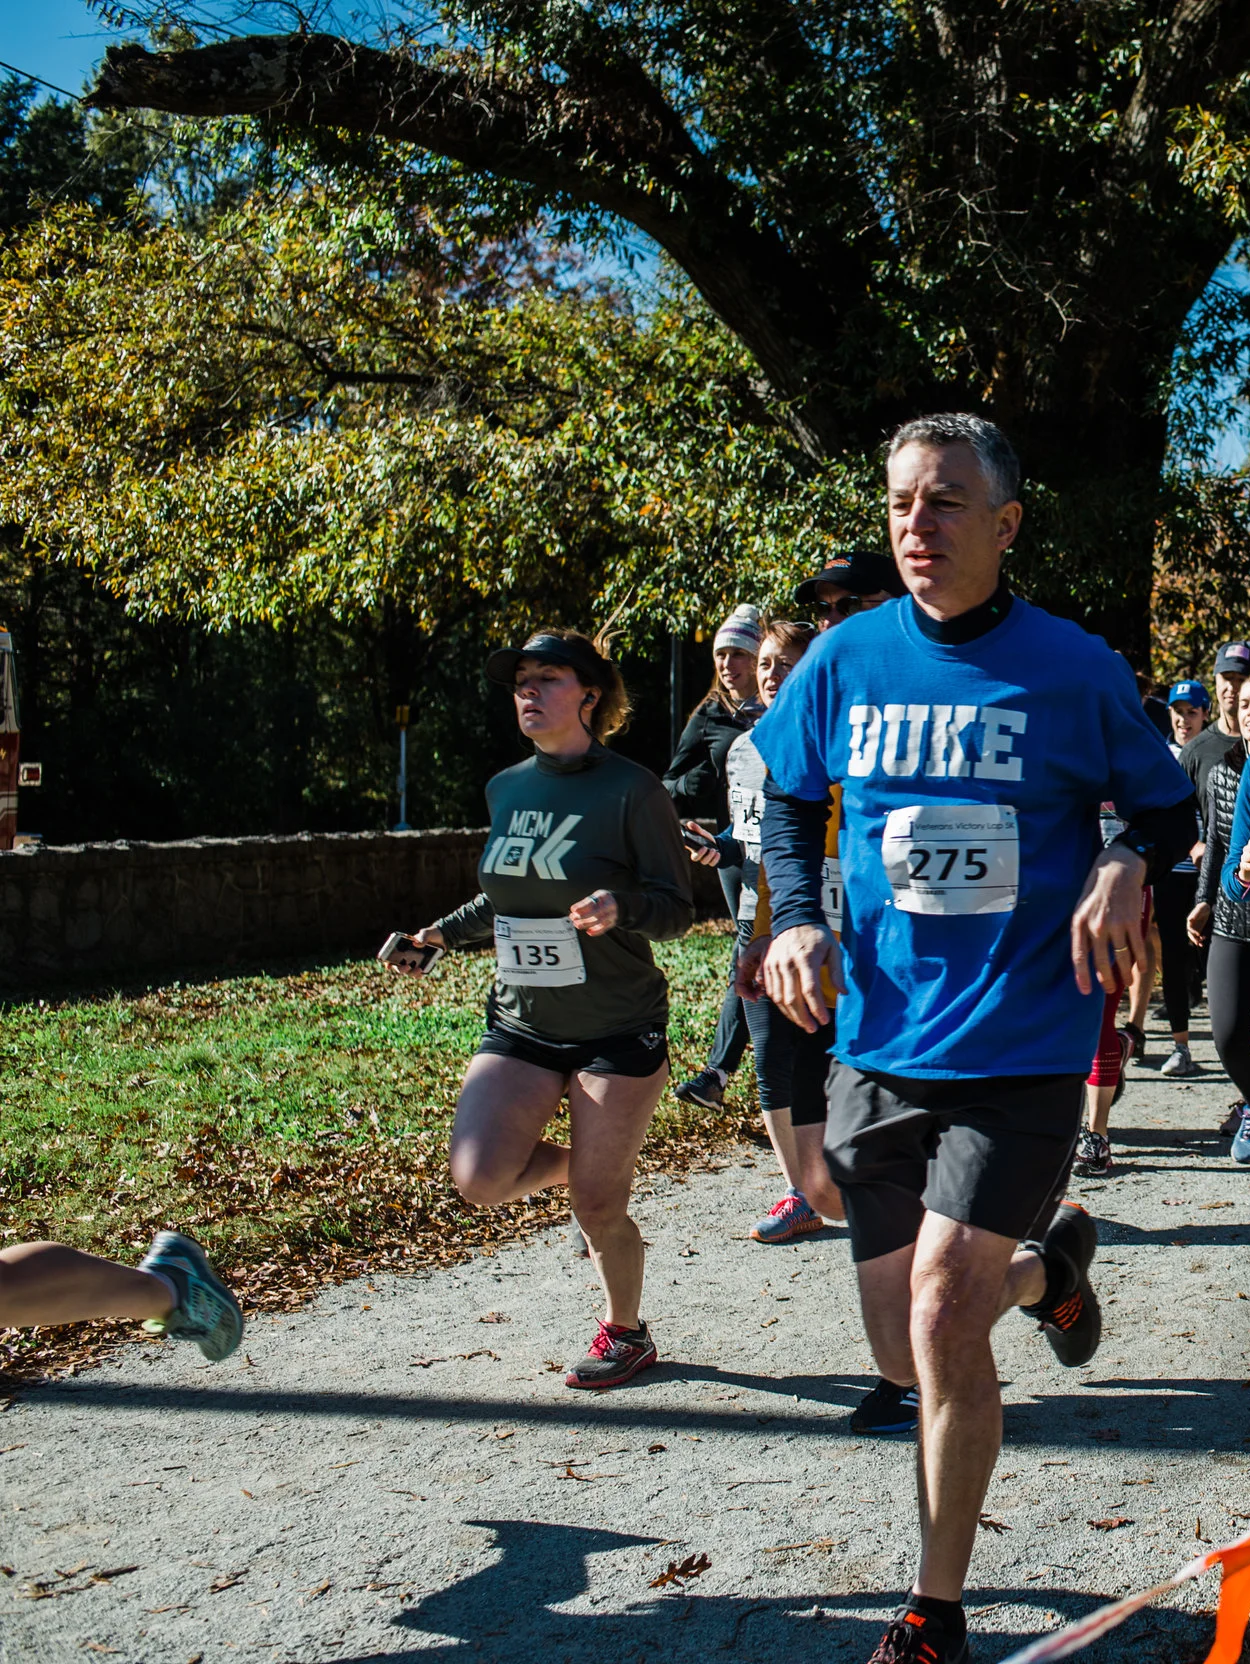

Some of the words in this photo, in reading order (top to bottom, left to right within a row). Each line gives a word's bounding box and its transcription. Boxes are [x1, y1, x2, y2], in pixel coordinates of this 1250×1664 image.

[848, 704, 1028, 781] DUKE
[508, 810, 554, 838] MCM
[915, 822, 953, 831] Veterans
[956, 822, 984, 831] Victory
[987, 822, 1003, 831] Lap
[908, 848, 988, 881] 275
[512, 945, 560, 966] 135
